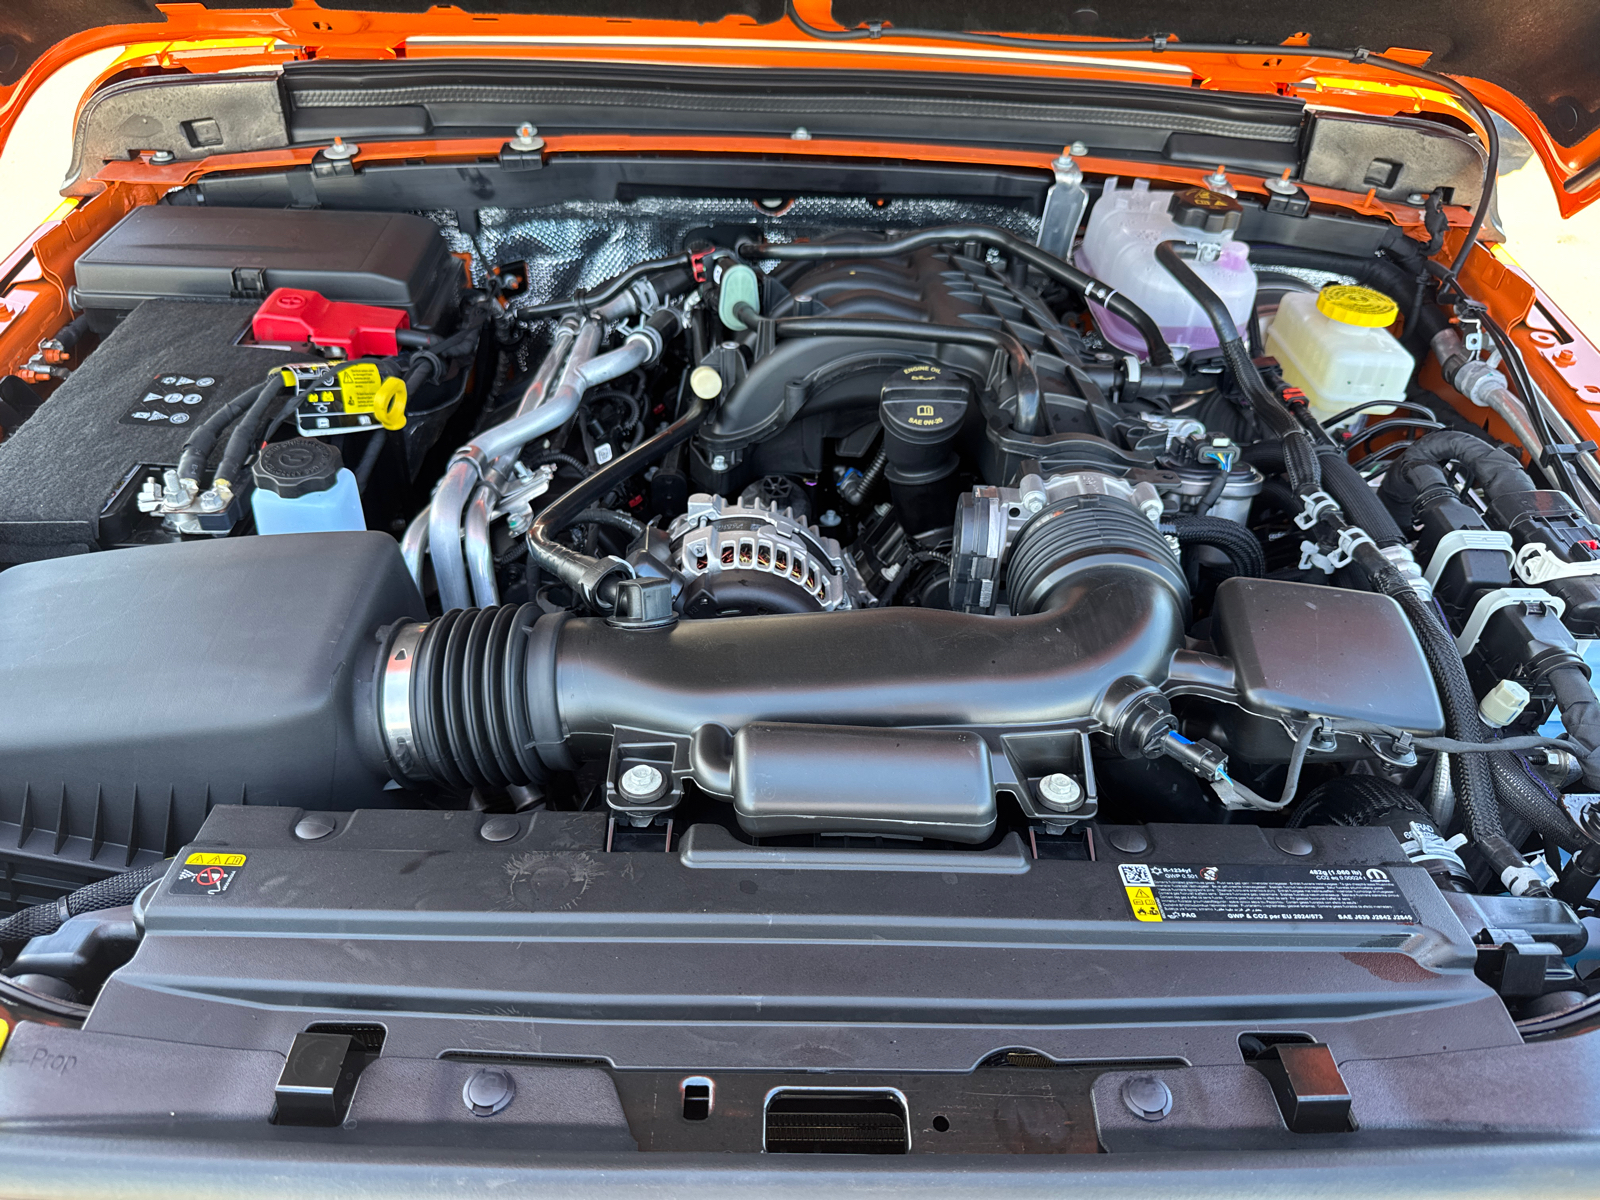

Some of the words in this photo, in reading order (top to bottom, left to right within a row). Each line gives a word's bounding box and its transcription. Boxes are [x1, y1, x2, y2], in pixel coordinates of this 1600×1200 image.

[903, 365, 930, 375] ENGINE
[930, 366, 942, 375] OIL
[908, 417, 923, 425] SAE
[923, 417, 944, 426] 0W-20
[29, 1047, 78, 1076] Prop
